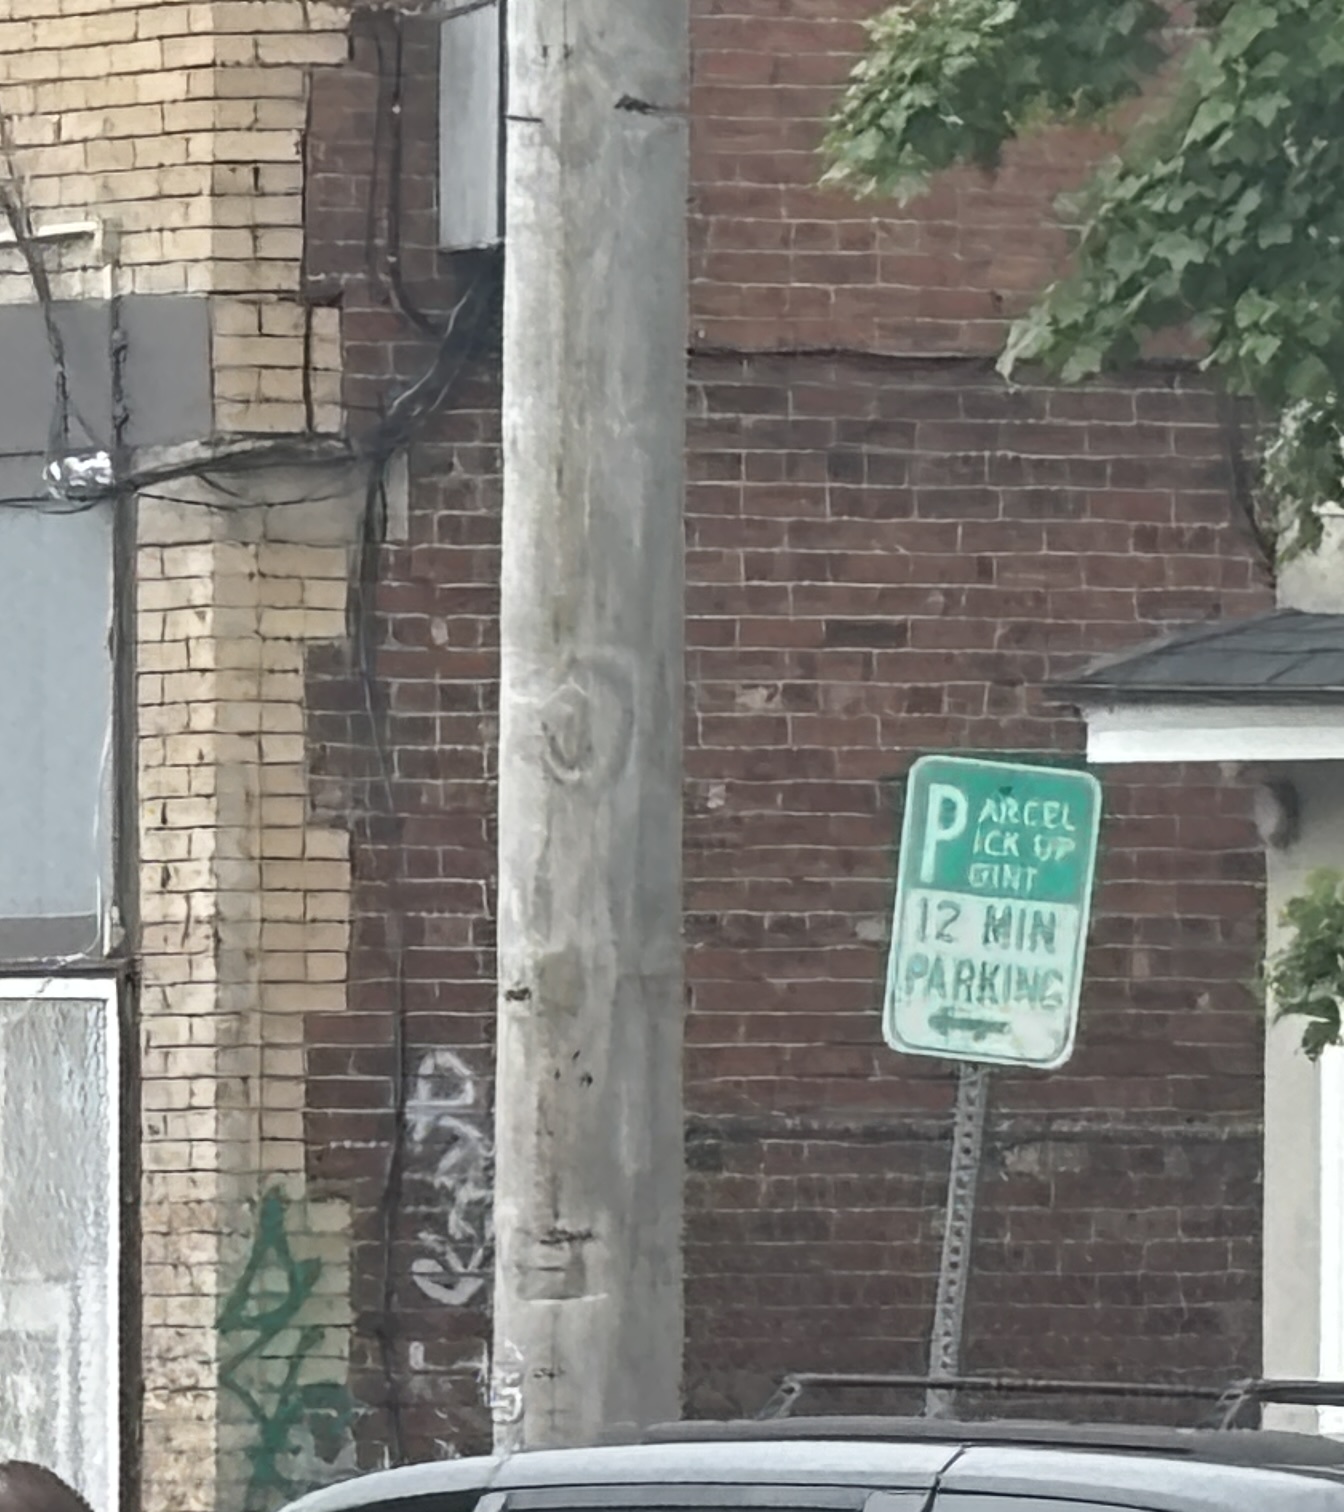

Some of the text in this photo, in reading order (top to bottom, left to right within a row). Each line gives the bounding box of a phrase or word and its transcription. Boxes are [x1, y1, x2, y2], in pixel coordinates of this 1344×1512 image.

[1033, 835, 1077, 862] UP
[918, 895, 1057, 955] 12 MIN
[903, 952, 1066, 1010] PARKING
